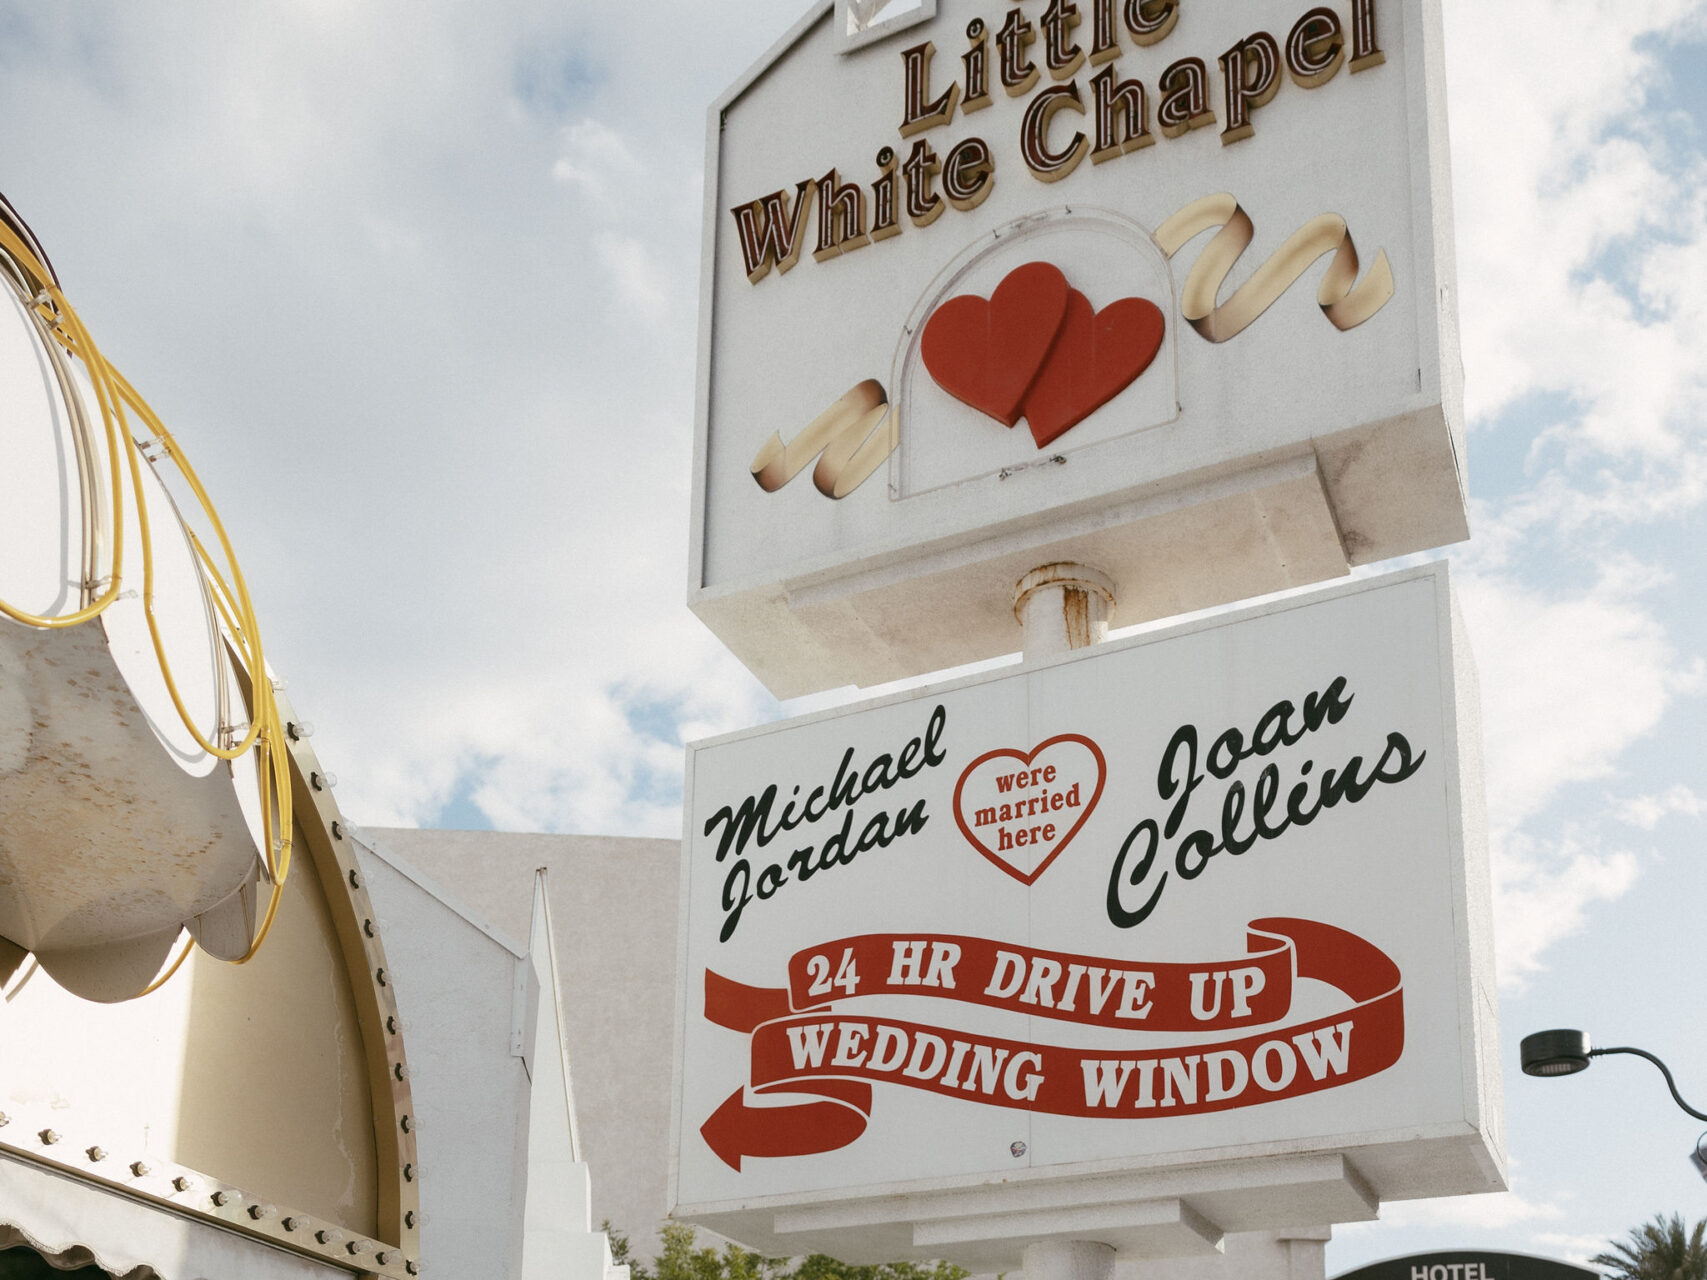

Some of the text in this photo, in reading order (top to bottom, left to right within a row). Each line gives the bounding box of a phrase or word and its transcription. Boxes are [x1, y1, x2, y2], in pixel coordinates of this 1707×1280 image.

[730, 0, 1386, 285] White Chapel
[704, 705, 947, 864] Michael
[974, 783, 1081, 829] married
[996, 762, 1057, 796] were
[1157, 676, 1355, 840] Joan
[719, 799, 930, 943] Jordan
[998, 820, 1056, 852] here
[1106, 731, 1427, 929] Collins
[807, 941, 1267, 1021] 24 HR DRIVE UP
[786, 1022, 1355, 1109] WEDDING WINDOW
